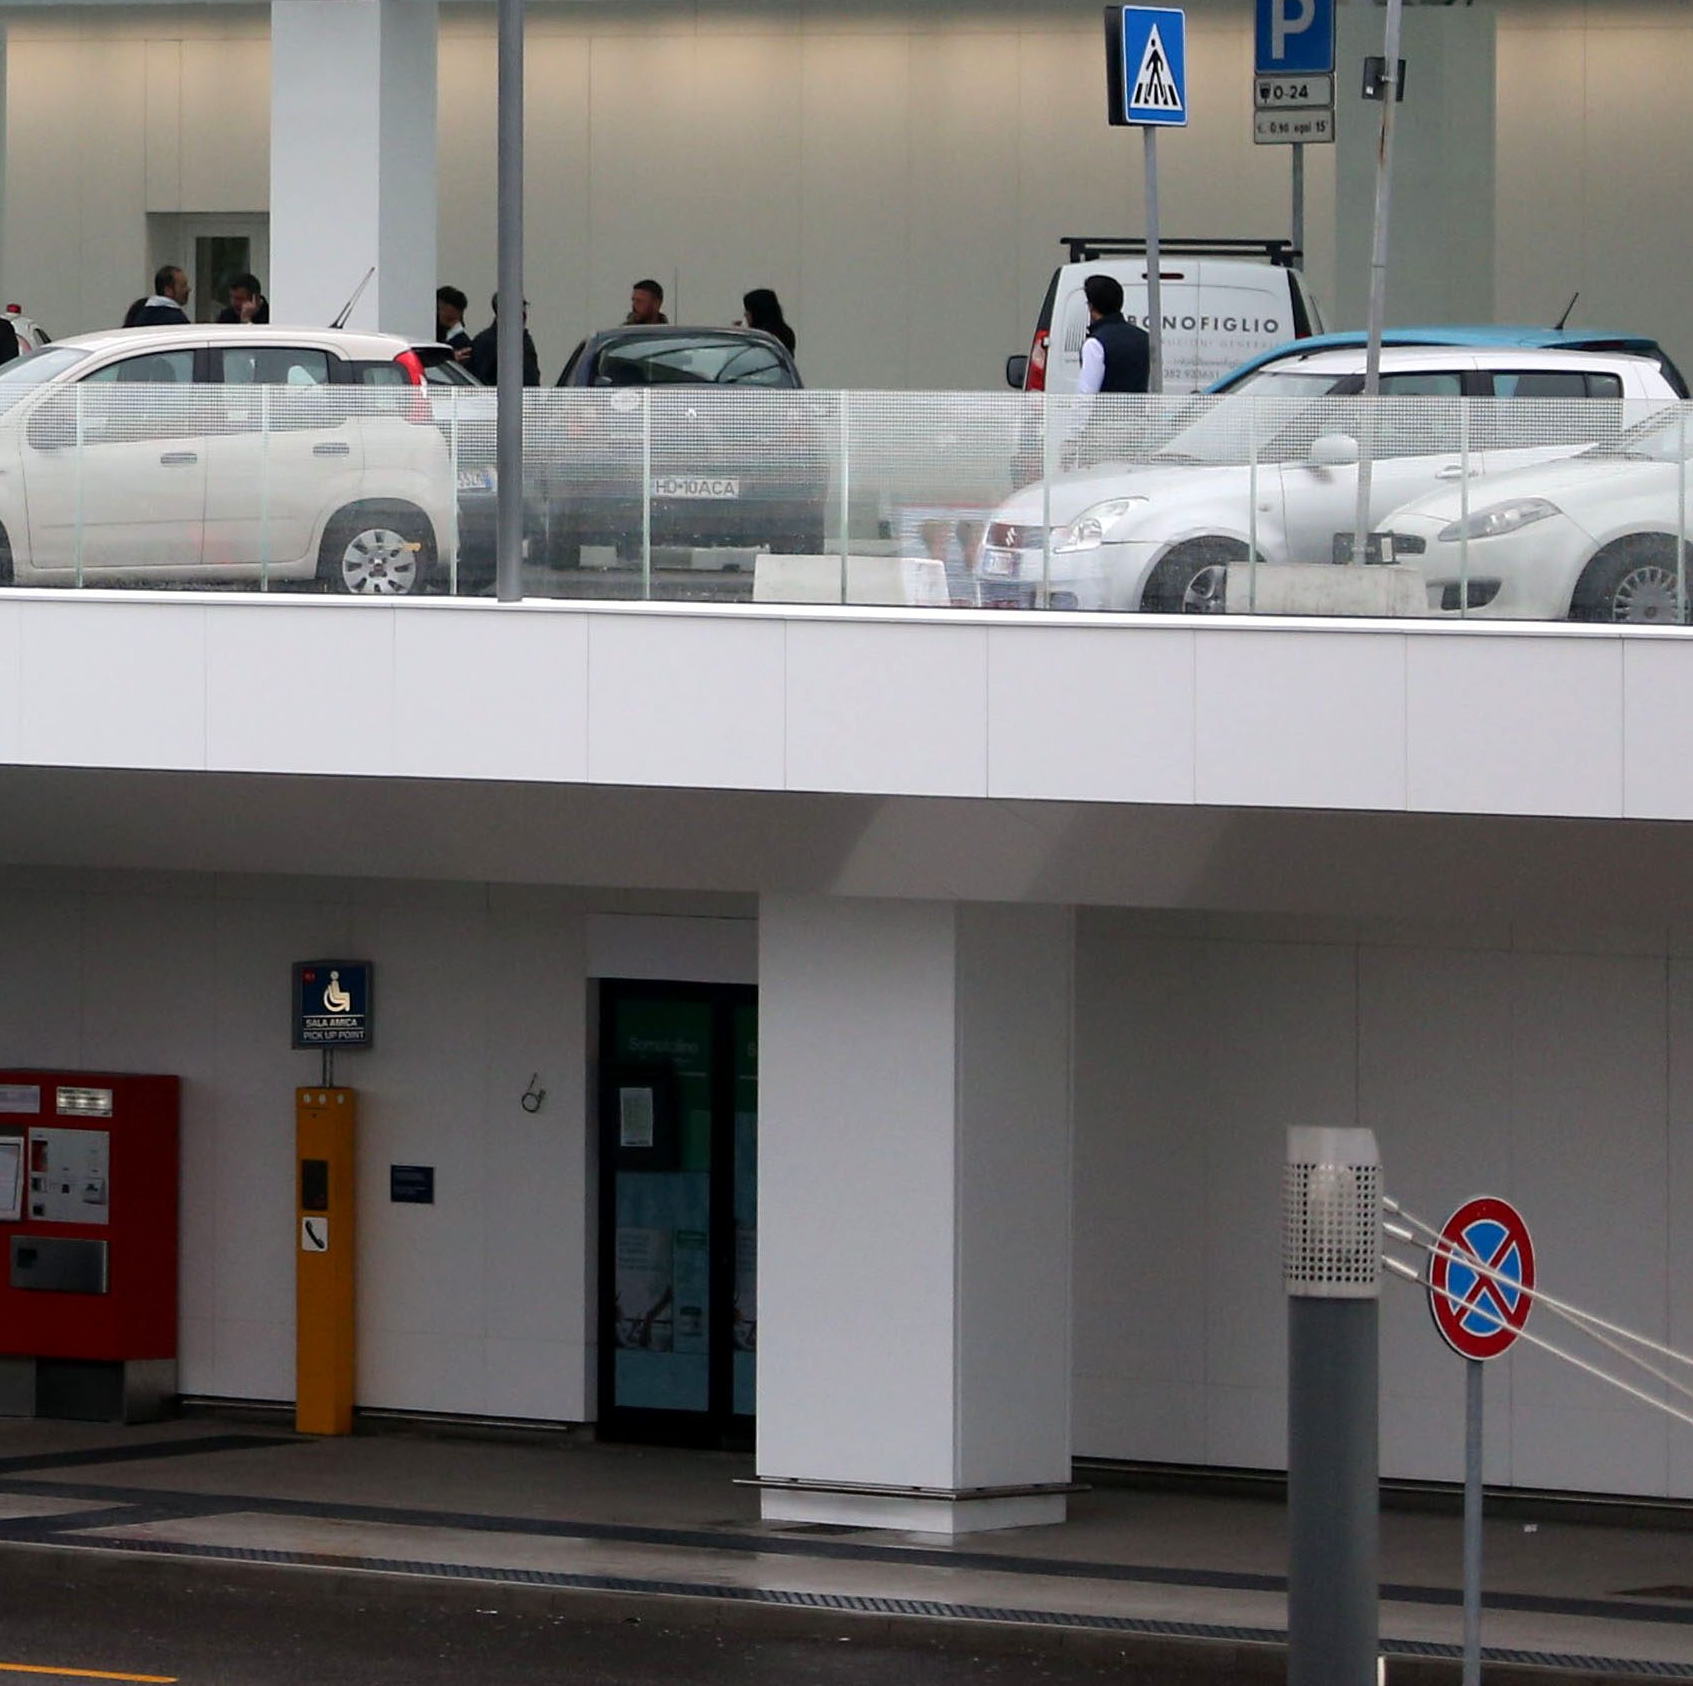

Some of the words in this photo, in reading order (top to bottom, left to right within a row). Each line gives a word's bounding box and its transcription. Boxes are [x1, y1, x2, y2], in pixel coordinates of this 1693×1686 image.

[305, 1018, 328, 1028] SALA
[329, 1018, 357, 1027] AMICA
[303, 1031, 323, 1040] PICK
[324, 1031, 337, 1039] UP
[338, 1031, 364, 1039] POINT
